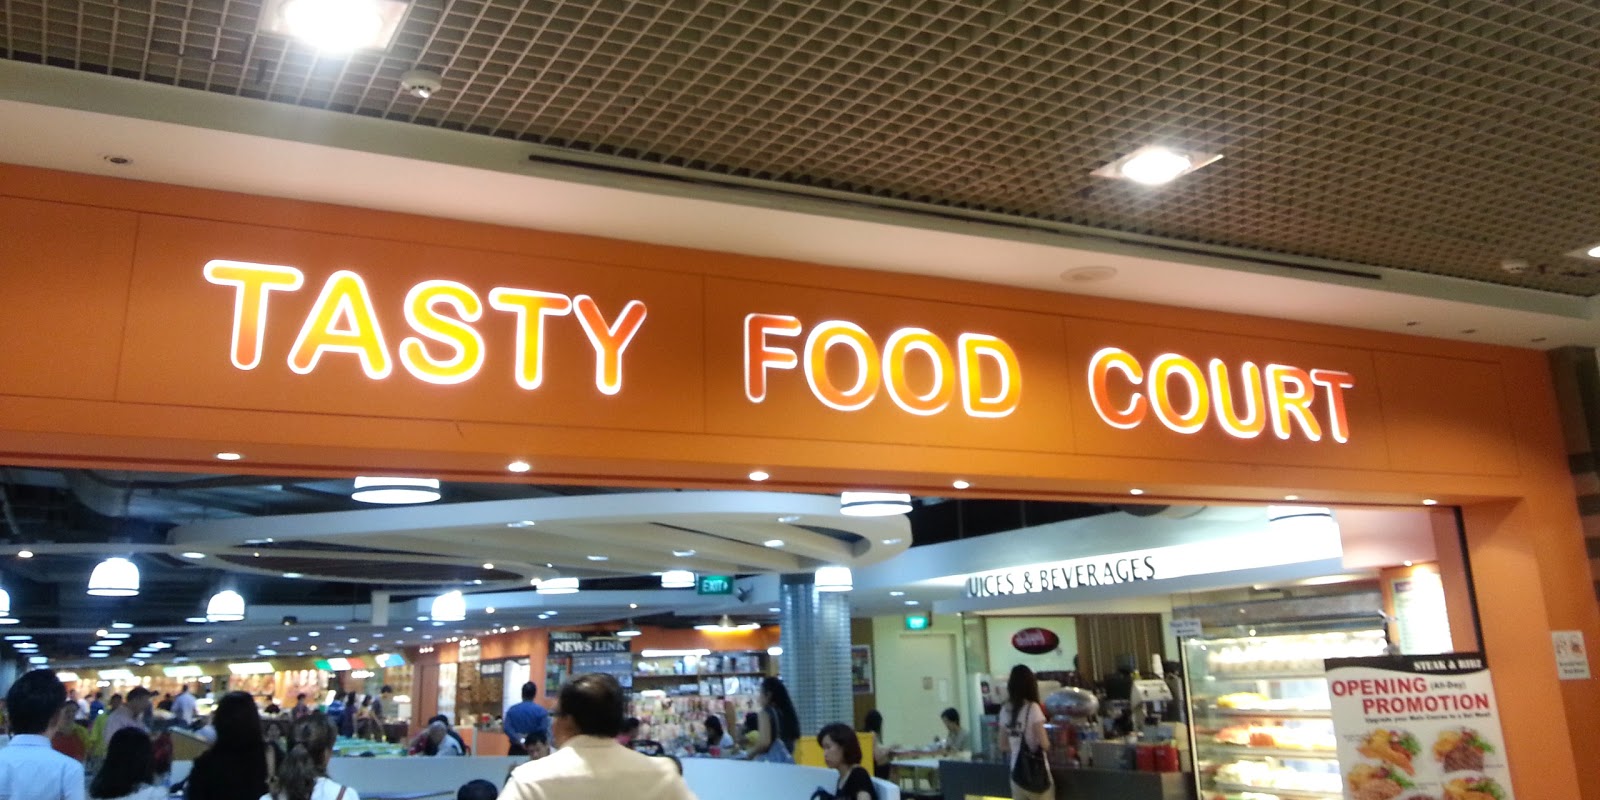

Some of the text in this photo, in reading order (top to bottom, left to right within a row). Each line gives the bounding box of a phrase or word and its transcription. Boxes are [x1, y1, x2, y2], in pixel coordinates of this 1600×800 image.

[203, 259, 1355, 443] TASTY FOOD COURT
[703, 579, 723, 592] EXIT
[968, 556, 1156, 597] UICES & BEVERAGES
[554, 641, 626, 652] NEWS LINK
[1413, 660, 1447, 670] STEAK
[1448, 660, 1457, 669] &
[1331, 677, 1427, 697] OPENING
[1362, 694, 1489, 715] PROMOTION
